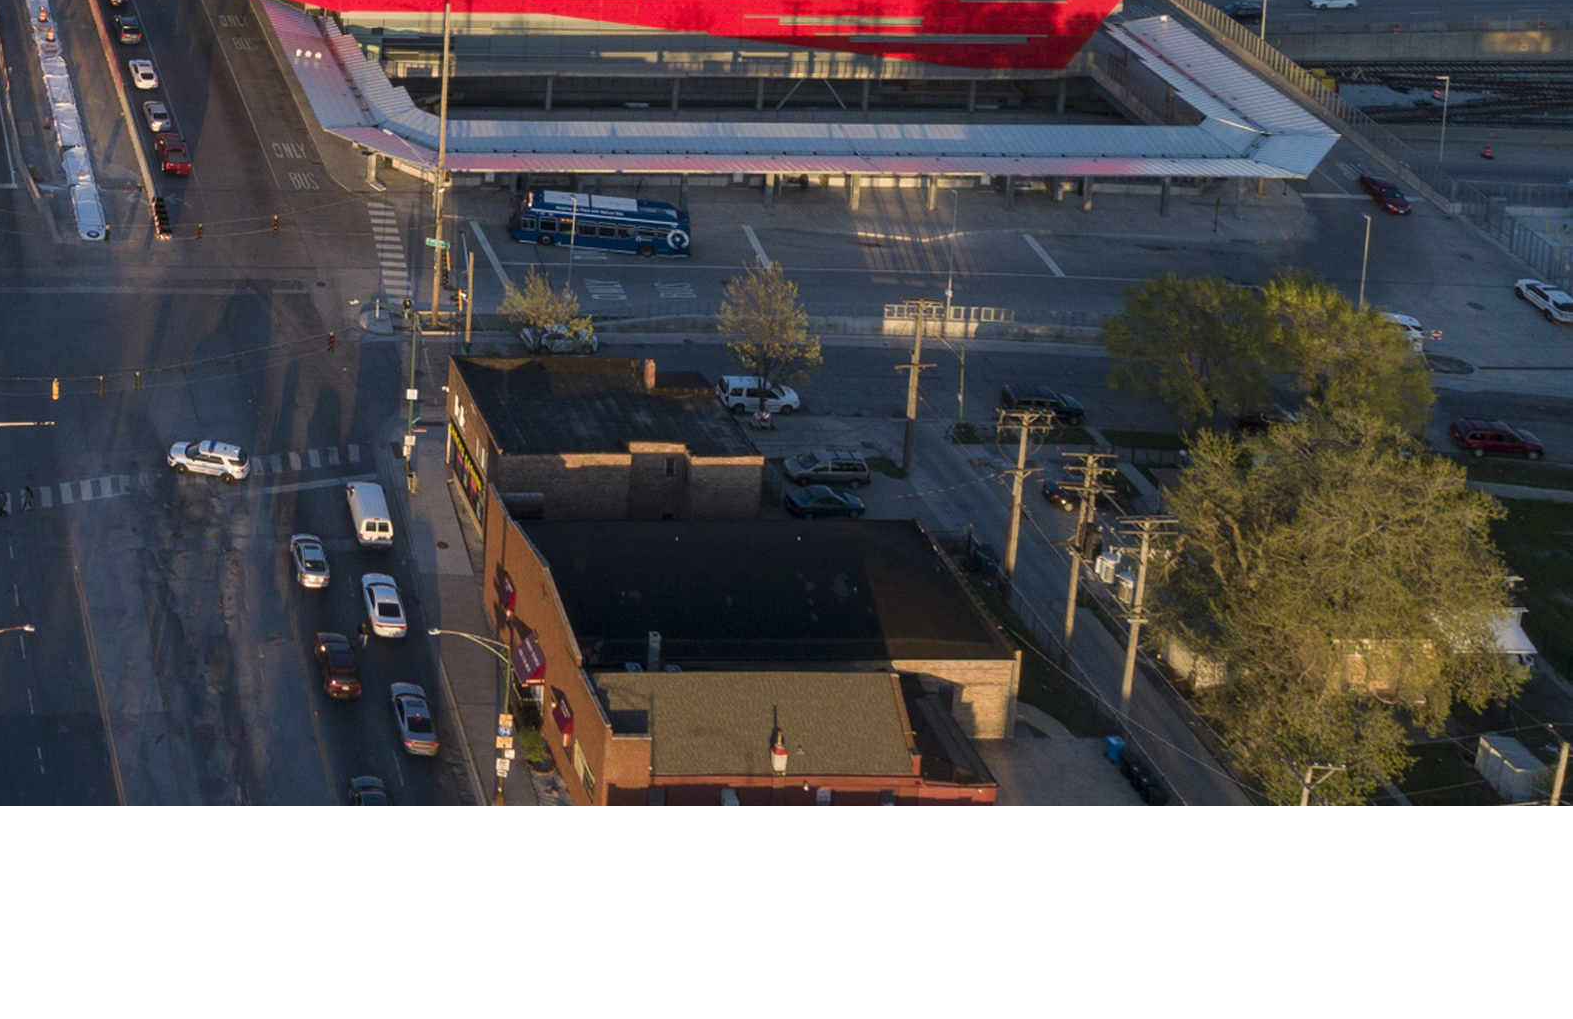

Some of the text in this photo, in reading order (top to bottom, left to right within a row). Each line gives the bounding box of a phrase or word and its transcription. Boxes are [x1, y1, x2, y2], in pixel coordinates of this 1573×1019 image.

[219, 15, 249, 28] ONLY
[233, 37, 259, 51] BUS
[272, 142, 307, 159] ONLY
[289, 172, 320, 190] BUS
